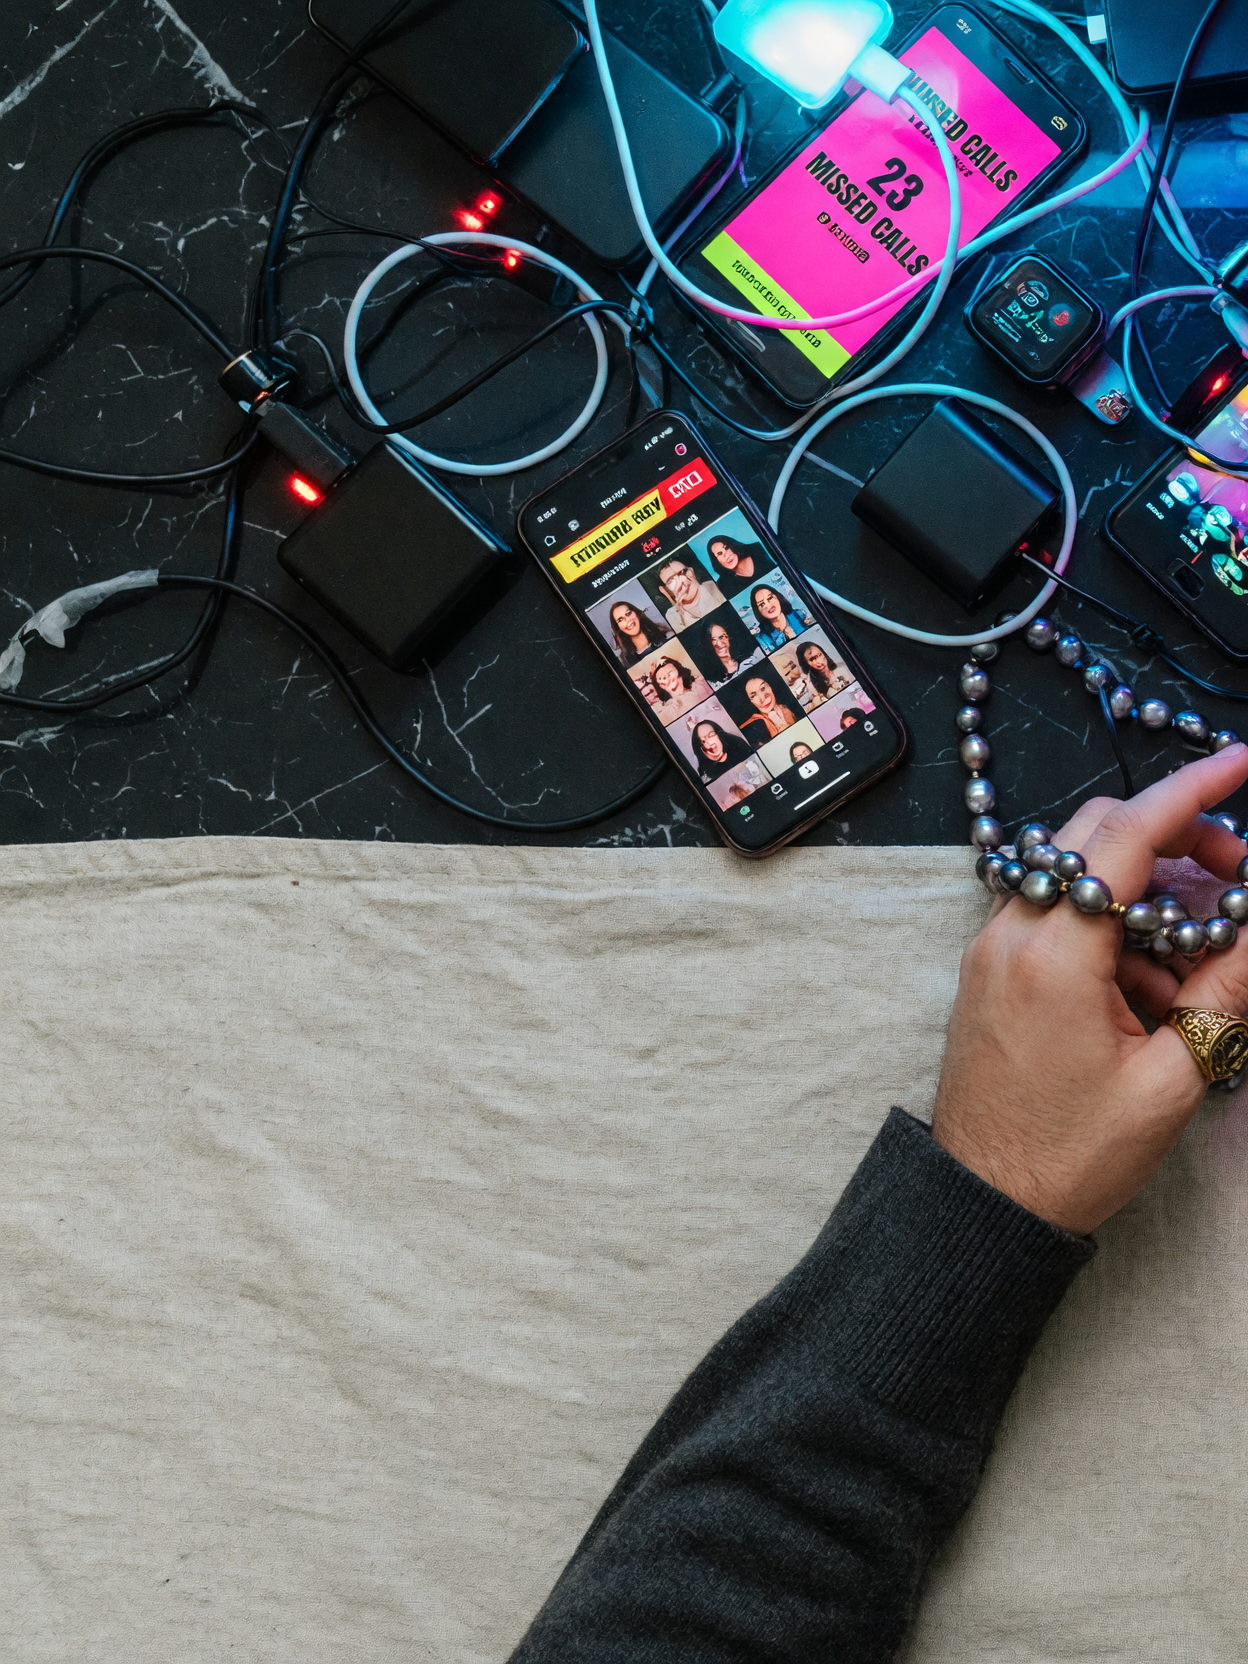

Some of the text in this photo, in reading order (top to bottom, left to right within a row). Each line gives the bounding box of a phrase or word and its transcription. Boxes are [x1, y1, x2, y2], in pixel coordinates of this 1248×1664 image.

[866, 157, 924, 212] 23
[960, 134, 1018, 192] CALLS
[805, 151, 878, 224] MISSED
[870, 217, 929, 276] CALLS
